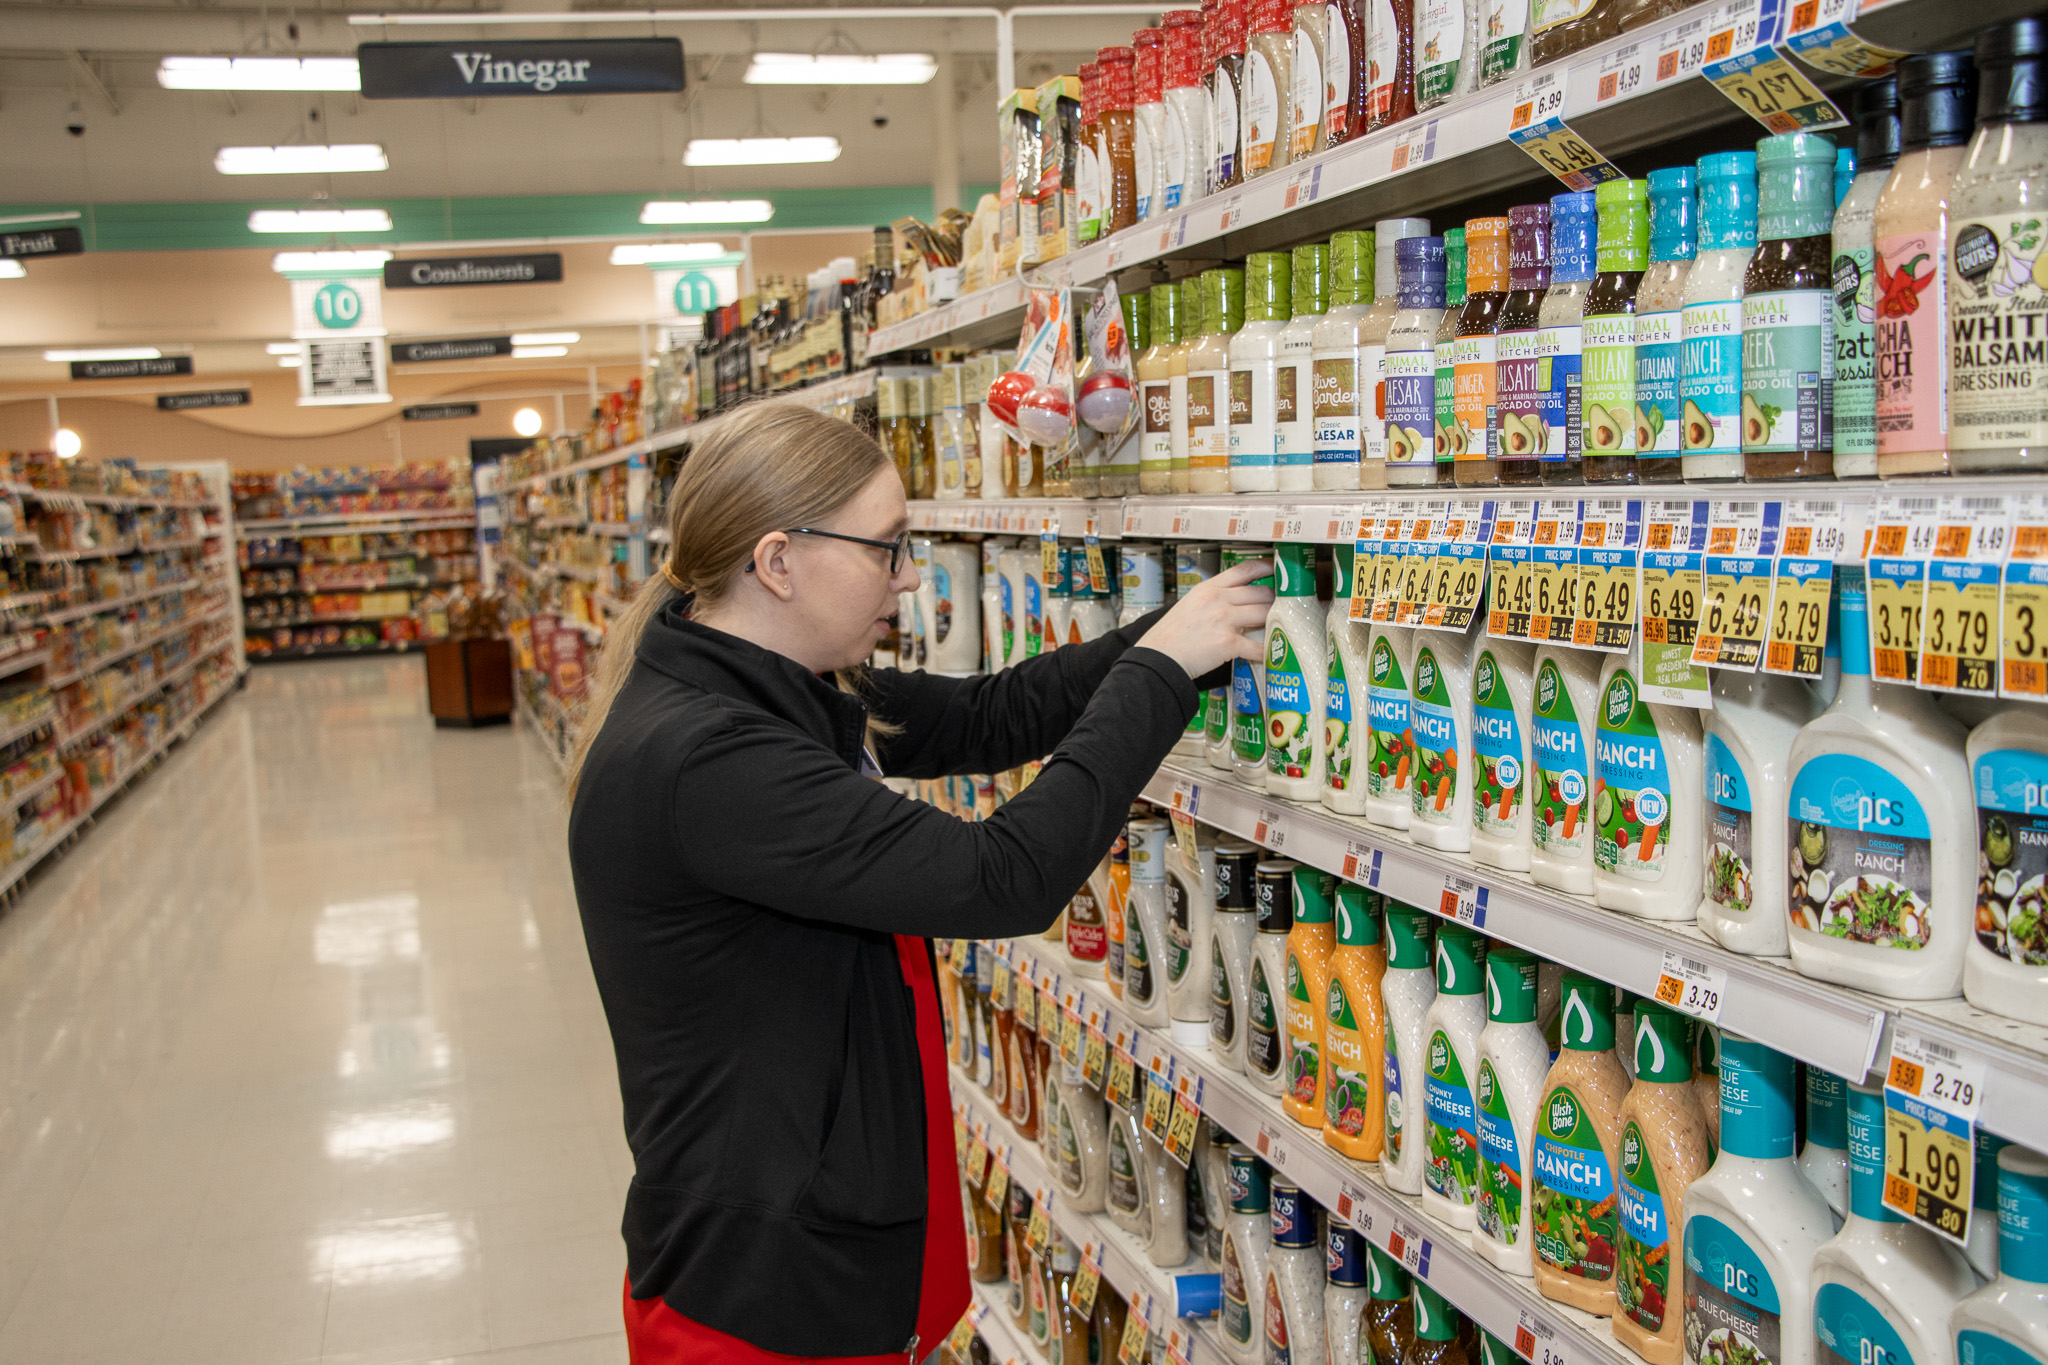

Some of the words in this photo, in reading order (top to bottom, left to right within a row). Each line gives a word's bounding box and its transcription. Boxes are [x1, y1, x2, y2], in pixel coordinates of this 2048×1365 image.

[1735, 20, 1756, 46] 3.99
[1680, 41, 1704, 69] 4.99
[1720, 60, 1739, 75] PRICE
[1740, 54, 1757, 69] CHOP
[452, 52, 590, 91] Vinegar
[1619, 64, 1641, 91] 4.99
[1538, 90, 1562, 115] 6.99
[1737, 72, 1814, 114] 2/$7
[1521, 129, 1536, 139] PRICE
[1535, 123, 1550, 136] CHOP
[1539, 140, 1597, 172] 6.49
[4, 234, 56, 252] Fruit
[1957, 244, 1997, 273] TOURS
[411, 262, 535, 285] Condiments
[1834, 274, 1859, 296] TOURS
[318, 289, 359, 320] 10
[680, 281, 712, 310] 11
[1951, 301, 1999, 318] Creamy
[1584, 320, 1635, 336] PRIMAL
[1584, 334, 1635, 345] KITCHEN
[408, 342, 496, 361] Condiments
[1386, 355, 1428, 368] PRIMAL
[1386, 366, 1429, 374] KITCHEN
[1642, 356, 1675, 380] ITALIAN
[1714, 384, 1736, 395] OIL
[1771, 378, 1794, 389] OIL
[1953, 371, 2032, 392] DRESSING
[1313, 390, 1360, 408] Garden
[1385, 379, 1422, 406] CAESAR
[1655, 390, 1675, 400] OIL
[1320, 421, 1341, 429] Classic
[1414, 412, 1431, 422] OIL
[1314, 429, 1355, 442] CAESAR
[1287, 521, 1302, 535] 5.49
[1464, 520, 1478, 536] 7.99
[1515, 521, 1530, 537] 7.99
[1559, 521, 1575, 539] 7.99
[1607, 522, 1624, 540] 7.99
[1672, 525, 1689, 545] 7.99
[1816, 527, 1837, 548] 4.49
[1740, 528, 1759, 548] 7.99
[1977, 527, 2004, 549] 4.49
[1449, 545, 1461, 555] PRICE
[1462, 545, 1474, 556] CHOP
[1502, 548, 1515, 559] PRICE
[1516, 549, 1527, 559] CHOP
[1545, 550, 1559, 560] PRICE
[1560, 550, 1572, 561] CHOP
[1592, 552, 1607, 563] PRICE
[1608, 553, 1622, 564] CHOP
[1655, 555, 1672, 567] PRICE
[1672, 555, 1688, 568] CHOP
[1721, 560, 1738, 572] PRICE
[1739, 561, 1755, 573] CHOP
[1788, 563, 1804, 574] PRICE
[1804, 563, 1820, 575] CHOP
[1881, 563, 1899, 576] PRICE
[1900, 564, 1918, 577] CHOP
[1942, 565, 1961, 578] PRICE
[1963, 567, 1982, 579] CHOP
[1437, 570, 1477, 606] 6.49
[1497, 575, 1531, 612] 6.49
[1539, 577, 1577, 616] 6.49
[1584, 580, 1630, 621] 6.49
[1650, 588, 1694, 619] 6.49
[1451, 610, 1471, 625] 1.50
[1709, 592, 1761, 637] 6.49
[1776, 600, 1820, 643] 3.79
[1607, 628, 1630, 645] 1.50
[1644, 621, 1664, 639] 25.96
[1931, 608, 1988, 655] 3.79
[1374, 650, 1389, 665] Wish-
[1661, 648, 1682, 659] HONEST
[1797, 653, 1818, 673] .70
[1418, 662, 1433, 677] Wish-
[1658, 673, 1671, 684] REAL
[1672, 671, 1691, 683] FLAVOR
[1962, 668, 1989, 689] .70
[1539, 674, 1554, 690] Wish-
[1267, 687, 1299, 704] RANCH
[1609, 686, 1630, 705] Wish-
[1532, 725, 1576, 754] RANCH
[1597, 738, 1656, 771] RANCH
[1500, 764, 1515, 779] NEW
[1600, 763, 1644, 780] DRESSING
[1564, 780, 1580, 795] NEW
[1715, 767, 1737, 800] pics
[1641, 800, 1660, 815] NEW
[1858, 792, 1905, 832] pics
[1270, 829, 1285, 846] 3.99
[1712, 822, 1738, 843] RANCH
[1868, 838, 1905, 852] DRESSING
[1357, 862, 1370, 880] 3.99
[1855, 852, 1905, 874] RANCH
[1458, 899, 1474, 919] 3.99
[1689, 985, 1718, 1011] 3.79
[1432, 1043, 1447, 1057] Wish-
[1894, 1064, 1916, 1088] 5.58
[1429, 1083, 1453, 1100] CHUNKY
[1933, 1072, 1974, 1106] 2.79
[1435, 1096, 1471, 1118] CHEESE
[1552, 1102, 1573, 1117] Wish-
[1904, 1099, 1927, 1119] PRICE
[1927, 1107, 1949, 1127] CHOP
[1477, 1114, 1496, 1132] CHUNKY
[1482, 1128, 1513, 1152] CHEESE
[1624, 1138, 1638, 1154] Wish-
[1545, 1142, 1585, 1162] CHIPOTLE
[1537, 1148, 1601, 1187] RANCH
[1898, 1131, 1960, 1200] 1.99
[1542, 1174, 1590, 1195] DRESSING
[1272, 1197, 1294, 1216] N'S
[1356, 1209, 1373, 1231] 3.99
[1936, 1209, 1961, 1233] .80
[1405, 1246, 1419, 1266] 3.99
[1724, 1262, 1759, 1297] pics
[1698, 1295, 1719, 1319] BLUE
[1719, 1309, 1759, 1339] CHEESE
[1731, 1302, 1759, 1319] DRESSING
